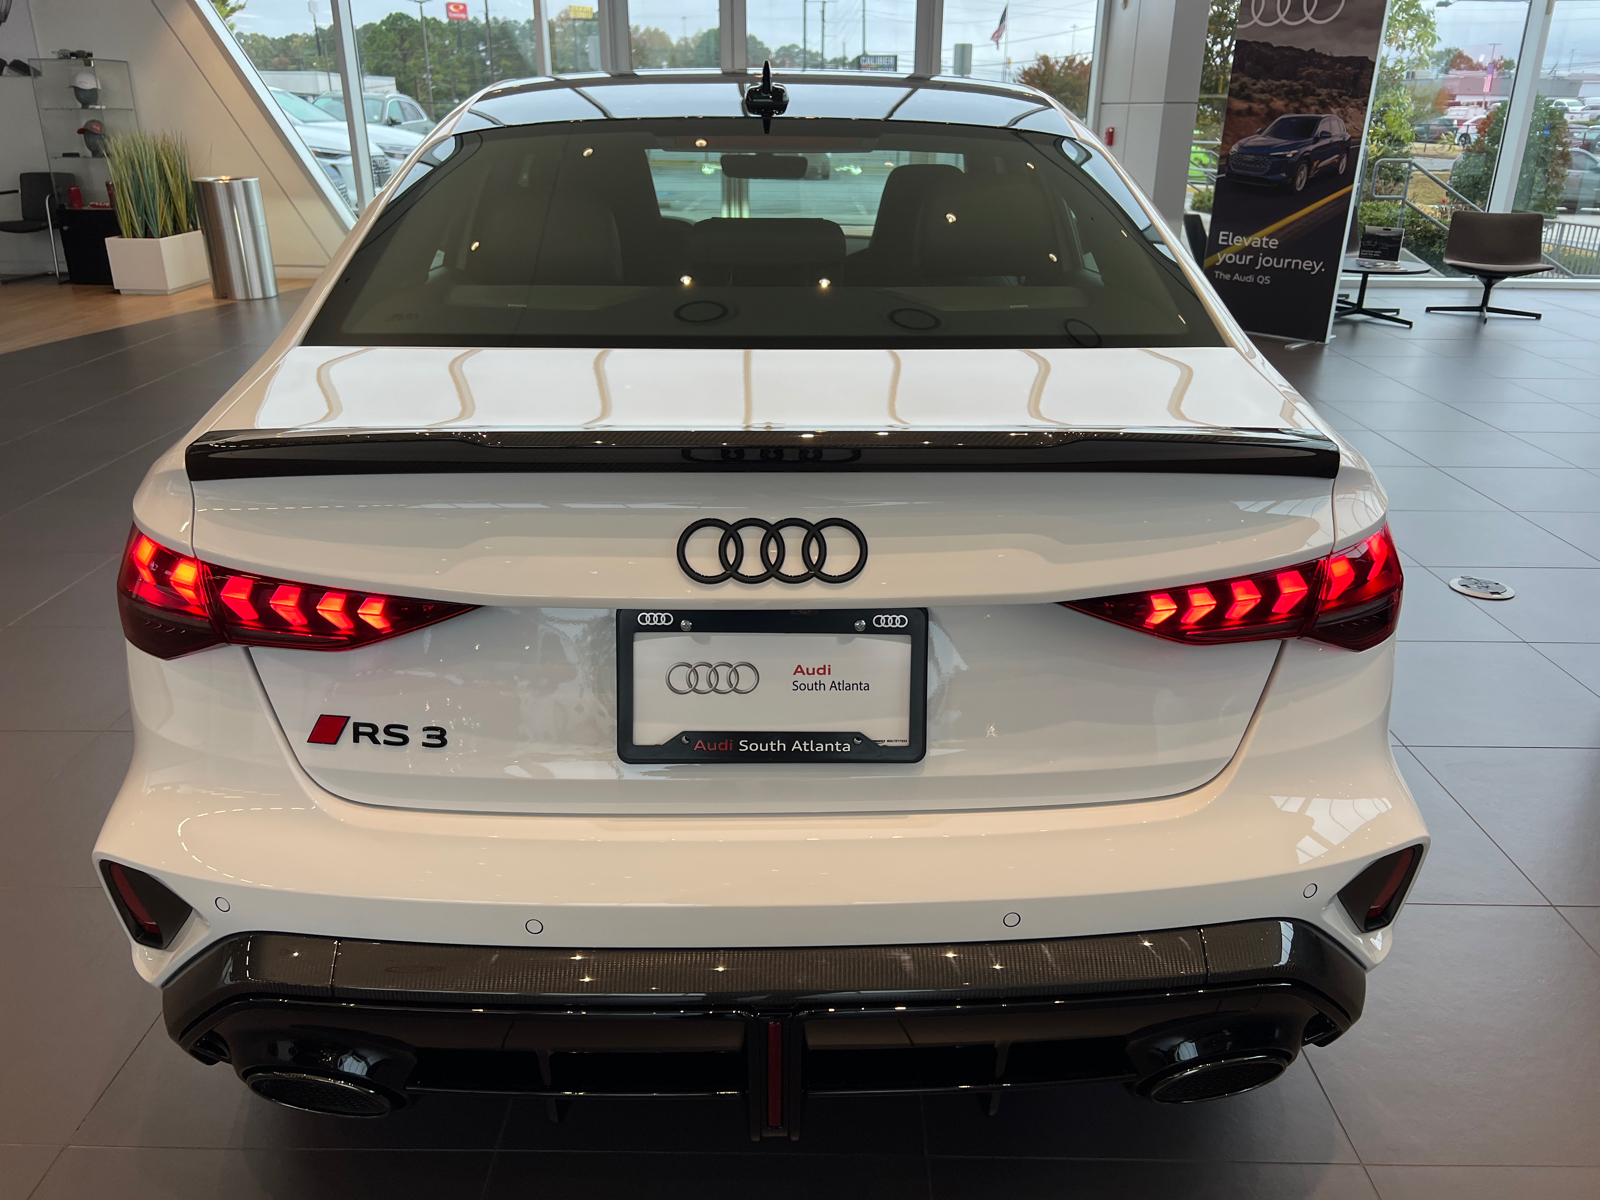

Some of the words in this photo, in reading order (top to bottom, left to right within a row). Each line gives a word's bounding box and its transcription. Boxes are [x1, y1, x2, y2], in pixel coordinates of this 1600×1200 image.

[1218, 231, 1279, 249] Elevate
[1215, 252, 1254, 266] your
[1255, 253, 1325, 275] journey.
[1214, 270, 1231, 281] The
[1232, 273, 1254, 283] Audi
[1256, 275, 1271, 285] Q5
[792, 664, 832, 676] Audi
[792, 680, 826, 692] South
[829, 680, 870, 692] Atlanta
[352, 721, 410, 747] RS
[421, 725, 448, 748] 3
[693, 739, 733, 751] Audi
[738, 739, 786, 752] South
[791, 740, 851, 752] Atlanta
